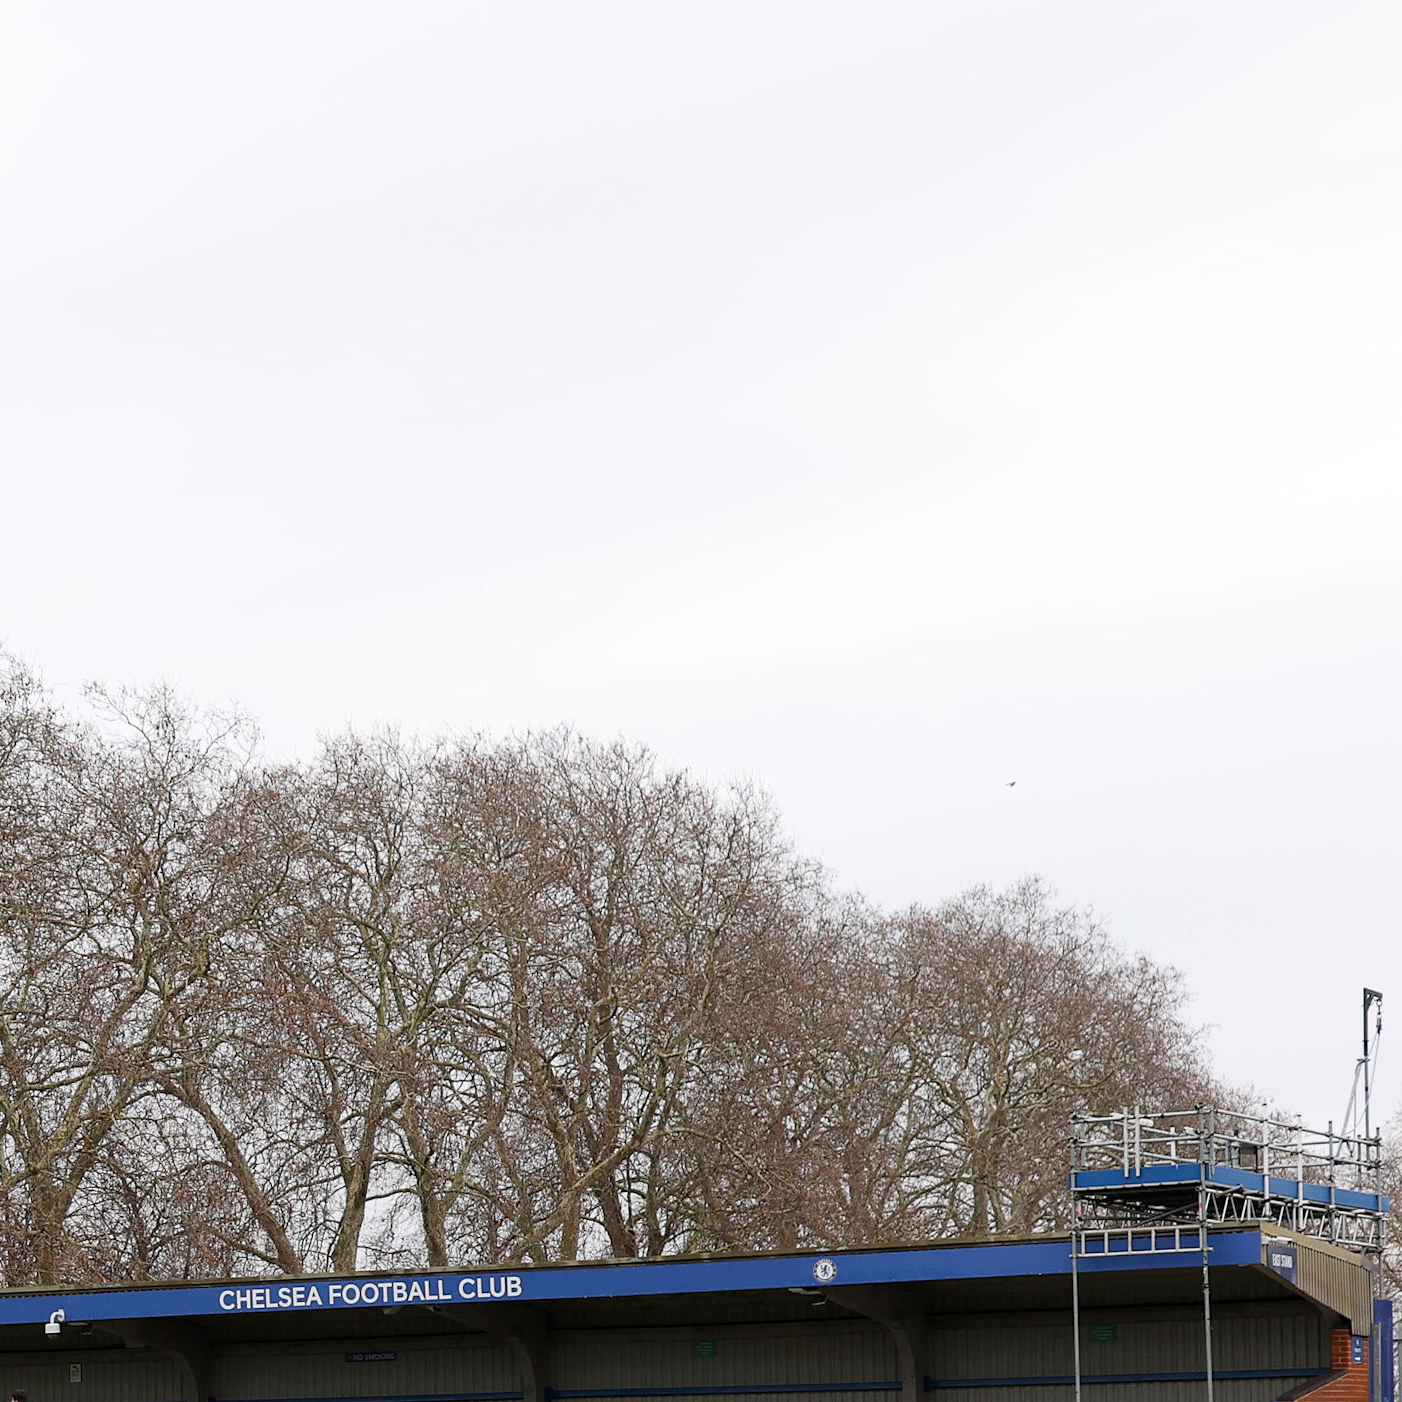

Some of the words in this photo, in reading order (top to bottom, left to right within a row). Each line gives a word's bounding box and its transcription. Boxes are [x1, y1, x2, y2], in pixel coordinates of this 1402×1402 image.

[219, 1286, 322, 1311] CHELSEA
[329, 1279, 452, 1305] FOOTBALL
[458, 1275, 523, 1299] CLUB
